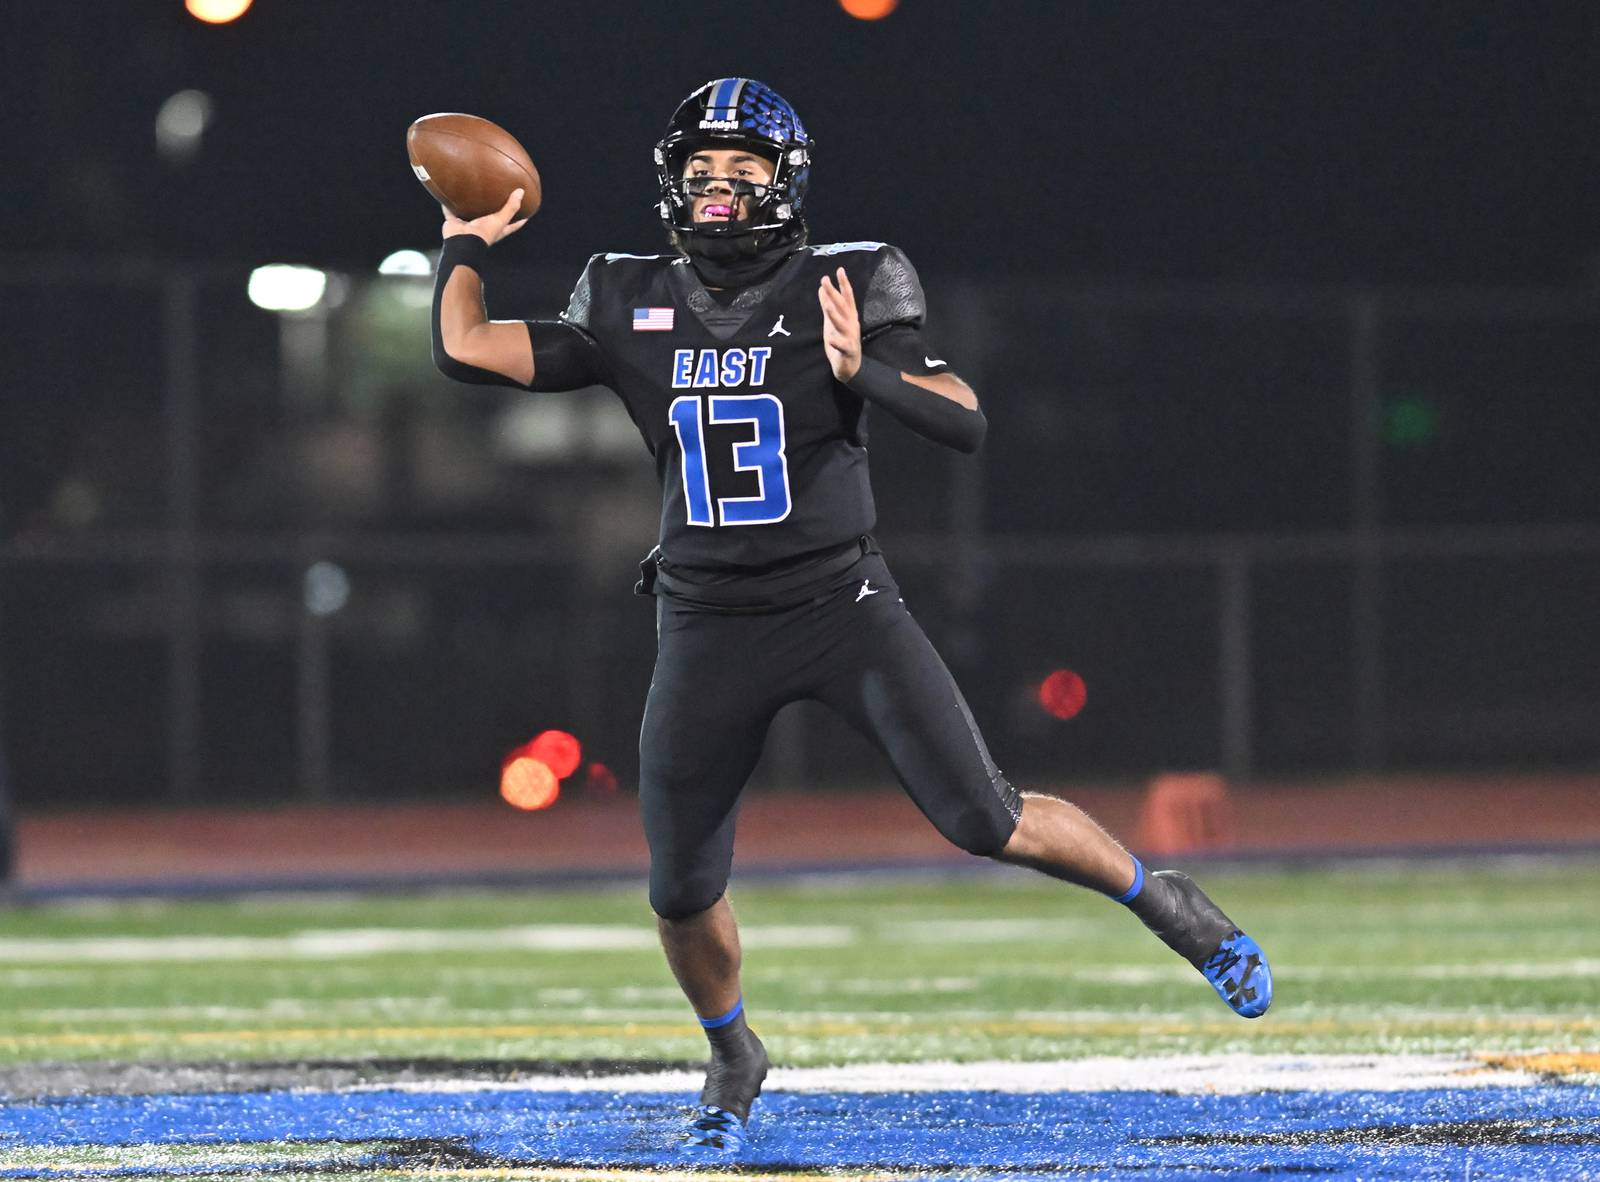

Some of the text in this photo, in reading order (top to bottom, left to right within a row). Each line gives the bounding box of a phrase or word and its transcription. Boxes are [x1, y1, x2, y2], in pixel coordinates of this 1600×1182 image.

[699, 120, 739, 130] Riddell
[672, 347, 772, 388] EAST
[668, 393, 792, 527] 13
